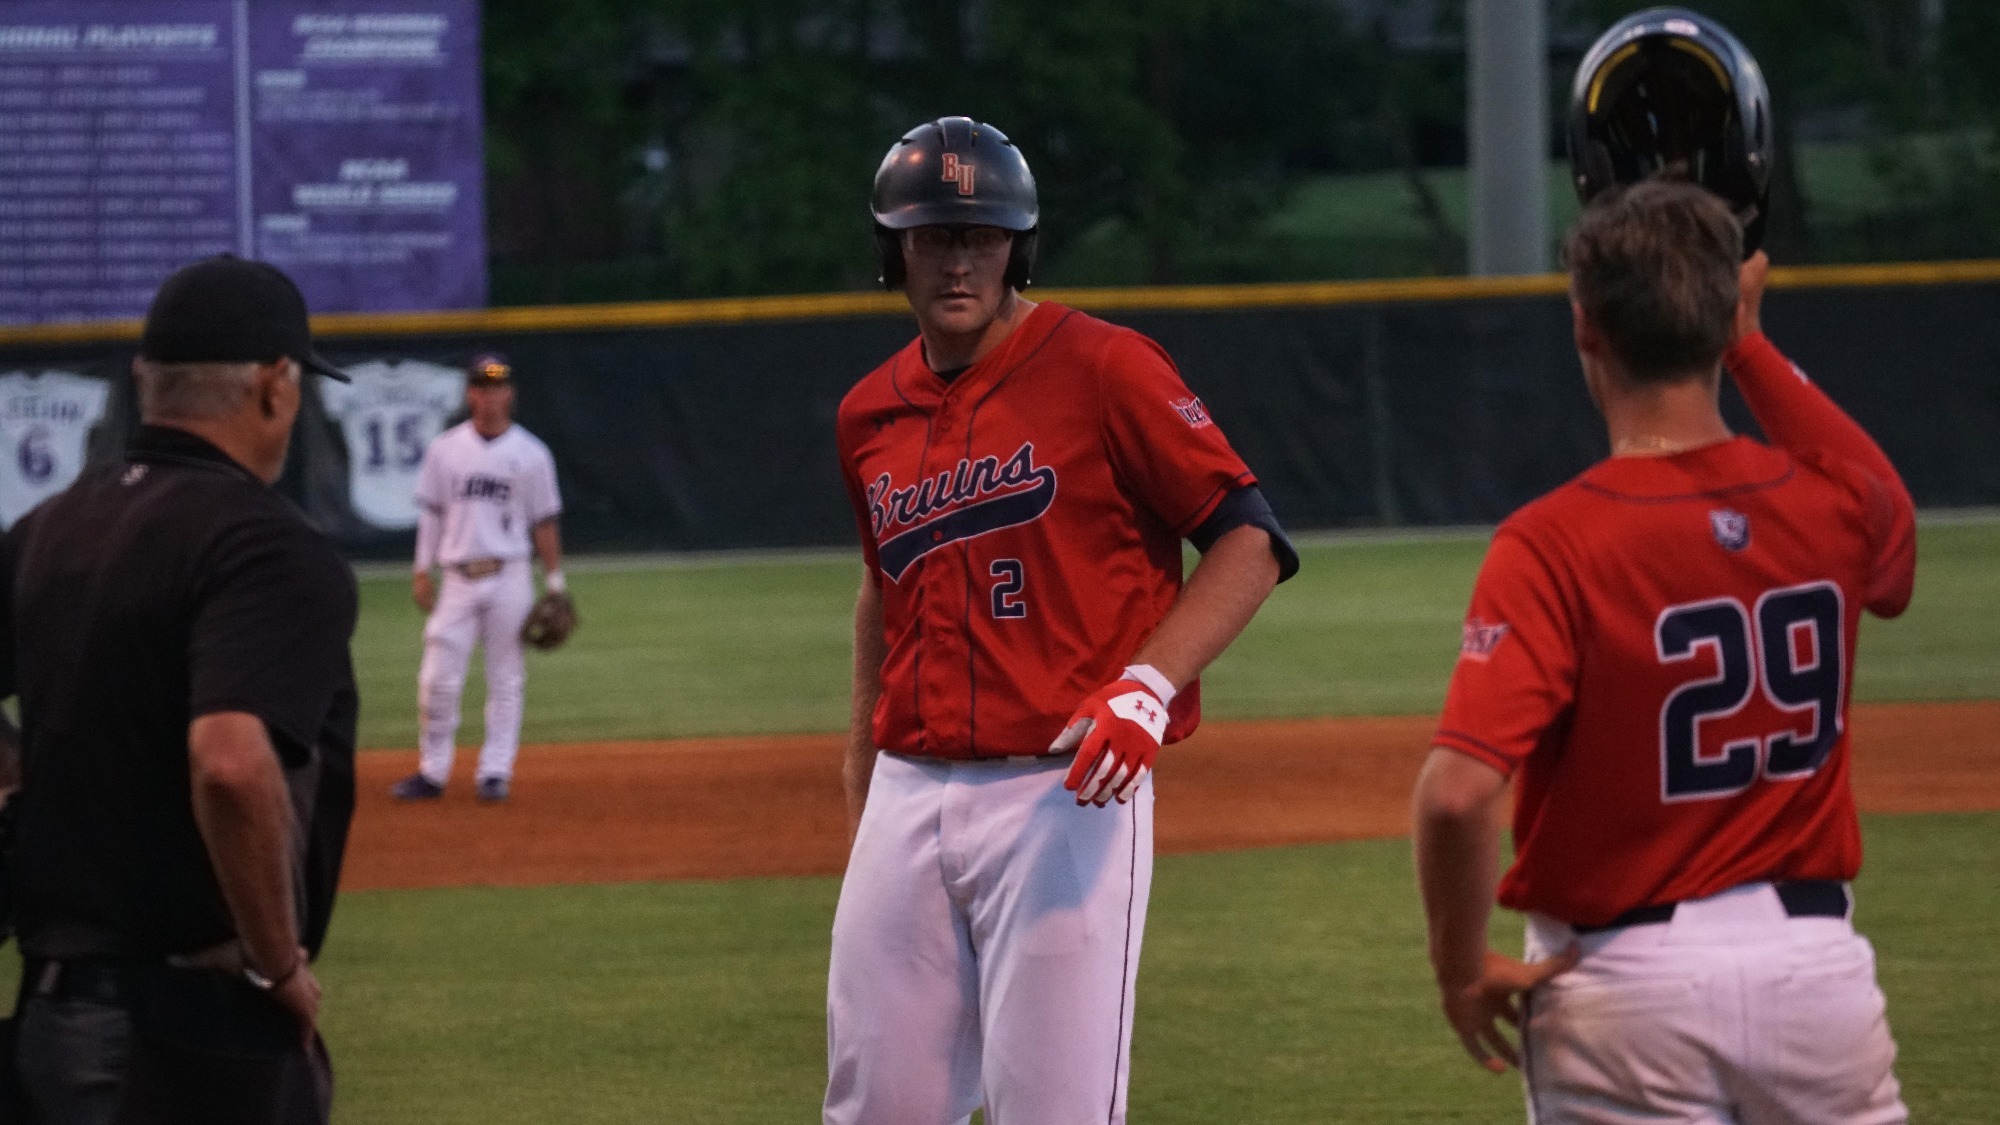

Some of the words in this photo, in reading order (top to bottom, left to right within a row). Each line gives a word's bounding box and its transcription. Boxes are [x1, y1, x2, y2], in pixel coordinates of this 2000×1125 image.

[942, 152, 975, 196] BU
[17, 422, 54, 485] 6
[366, 413, 424, 471] 15
[866, 440, 1040, 539] Bruins
[989, 558, 1027, 618] 2
[1653, 579, 1846, 804] 29
